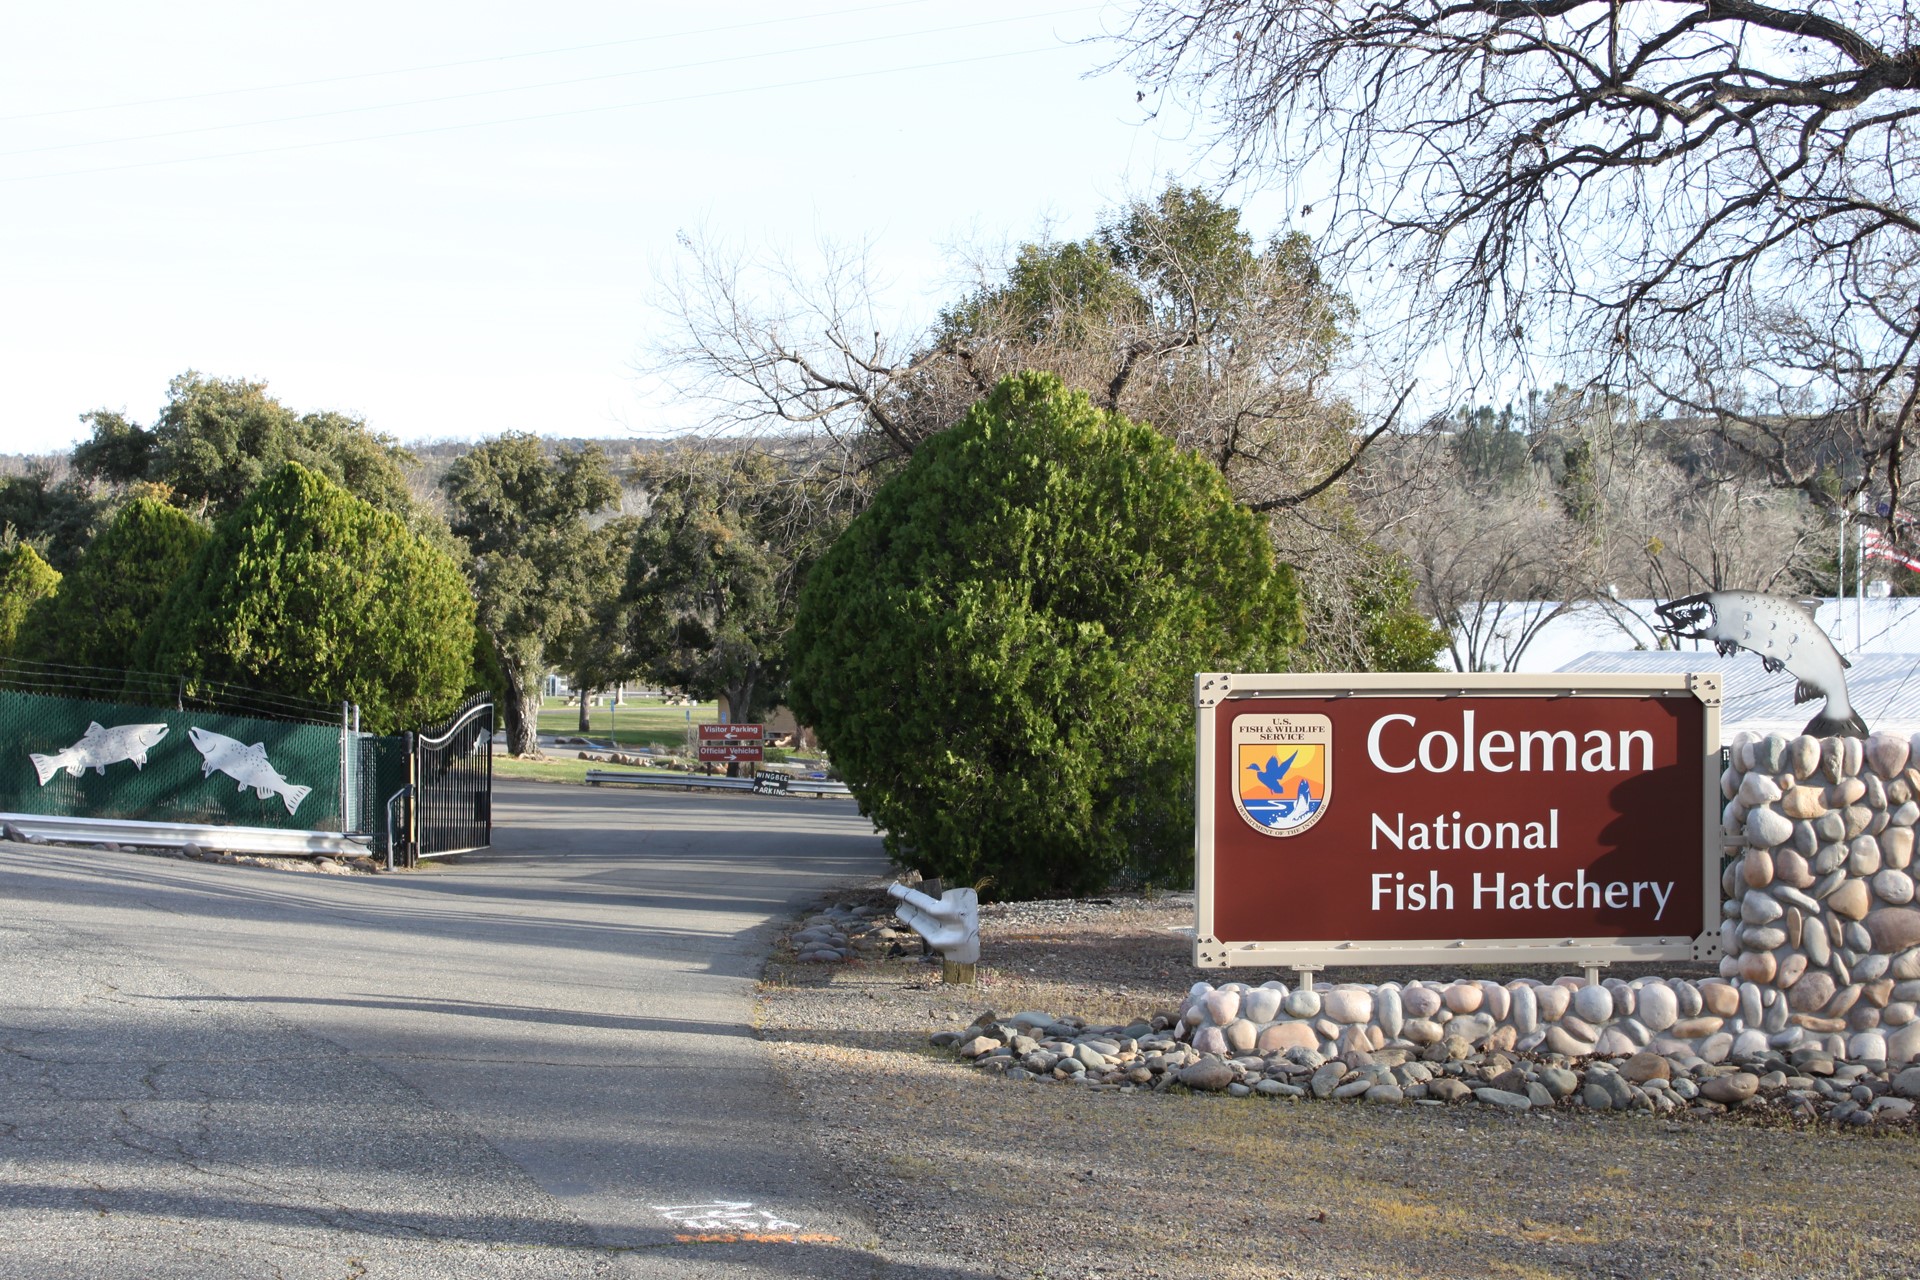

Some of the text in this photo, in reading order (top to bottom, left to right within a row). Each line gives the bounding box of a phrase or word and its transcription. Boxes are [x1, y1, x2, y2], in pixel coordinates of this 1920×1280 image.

[730, 726, 758, 734] Parking
[1259, 733, 1305, 741] SERVICE
[1367, 709, 1654, 774] Coleman
[753, 785, 786, 796] PARKING
[1287, 828, 1302, 836] THE
[1371, 808, 1559, 850] National
[1371, 868, 1675, 921] Fish Hatchery
